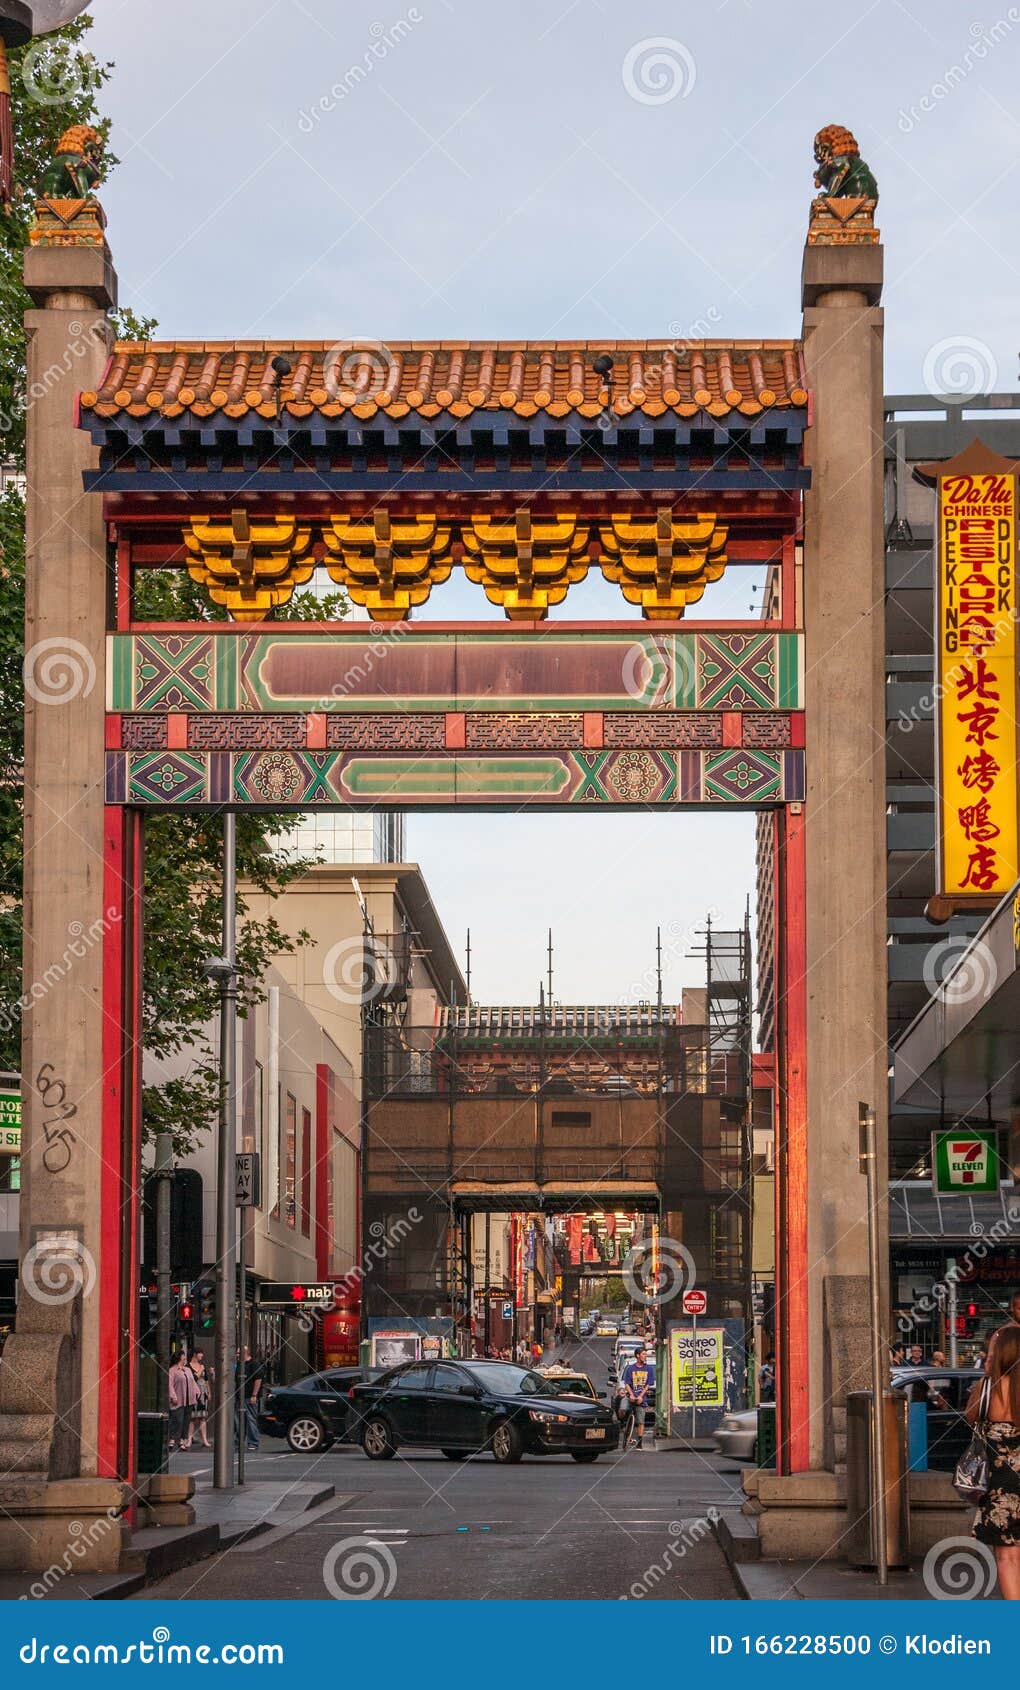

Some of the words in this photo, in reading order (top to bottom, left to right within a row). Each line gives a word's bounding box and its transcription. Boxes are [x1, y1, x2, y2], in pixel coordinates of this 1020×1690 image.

[943, 505, 1013, 517] CHINESE
[997, 518, 1010, 612] DUCK
[945, 518, 958, 653] PEKING
[959, 518, 996, 656] RESTAURANT
[236, 1159, 250, 1170] NE
[238, 1175, 250, 1187] AY
[307, 1286, 332, 1298] nab
[678, 1337, 716, 1349] Stereo
[680, 1347, 711, 1359] sonic
